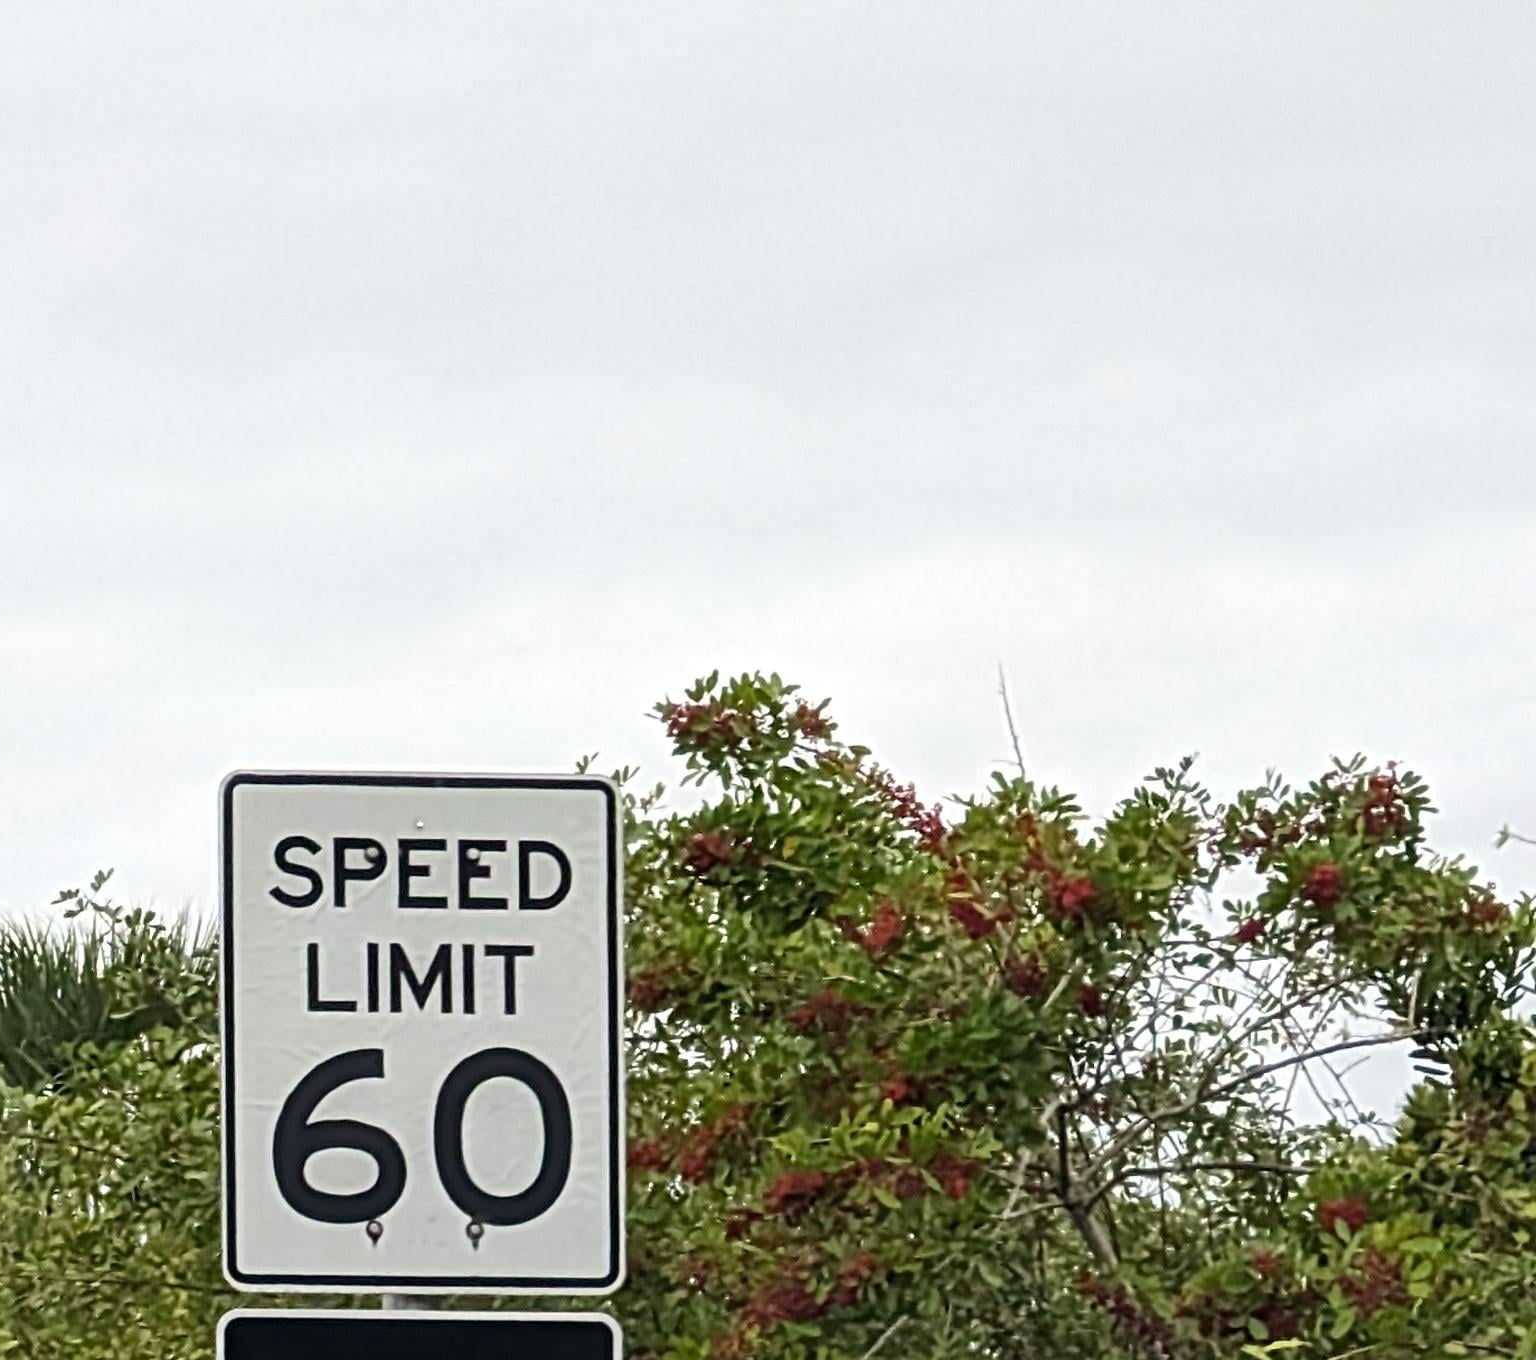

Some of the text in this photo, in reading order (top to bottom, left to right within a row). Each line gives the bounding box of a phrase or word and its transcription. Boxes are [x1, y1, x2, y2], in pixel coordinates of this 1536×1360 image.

[269, 835, 572, 910] SPEED
[307, 942, 535, 1015] LIMIT
[272, 1046, 573, 1227] 60
